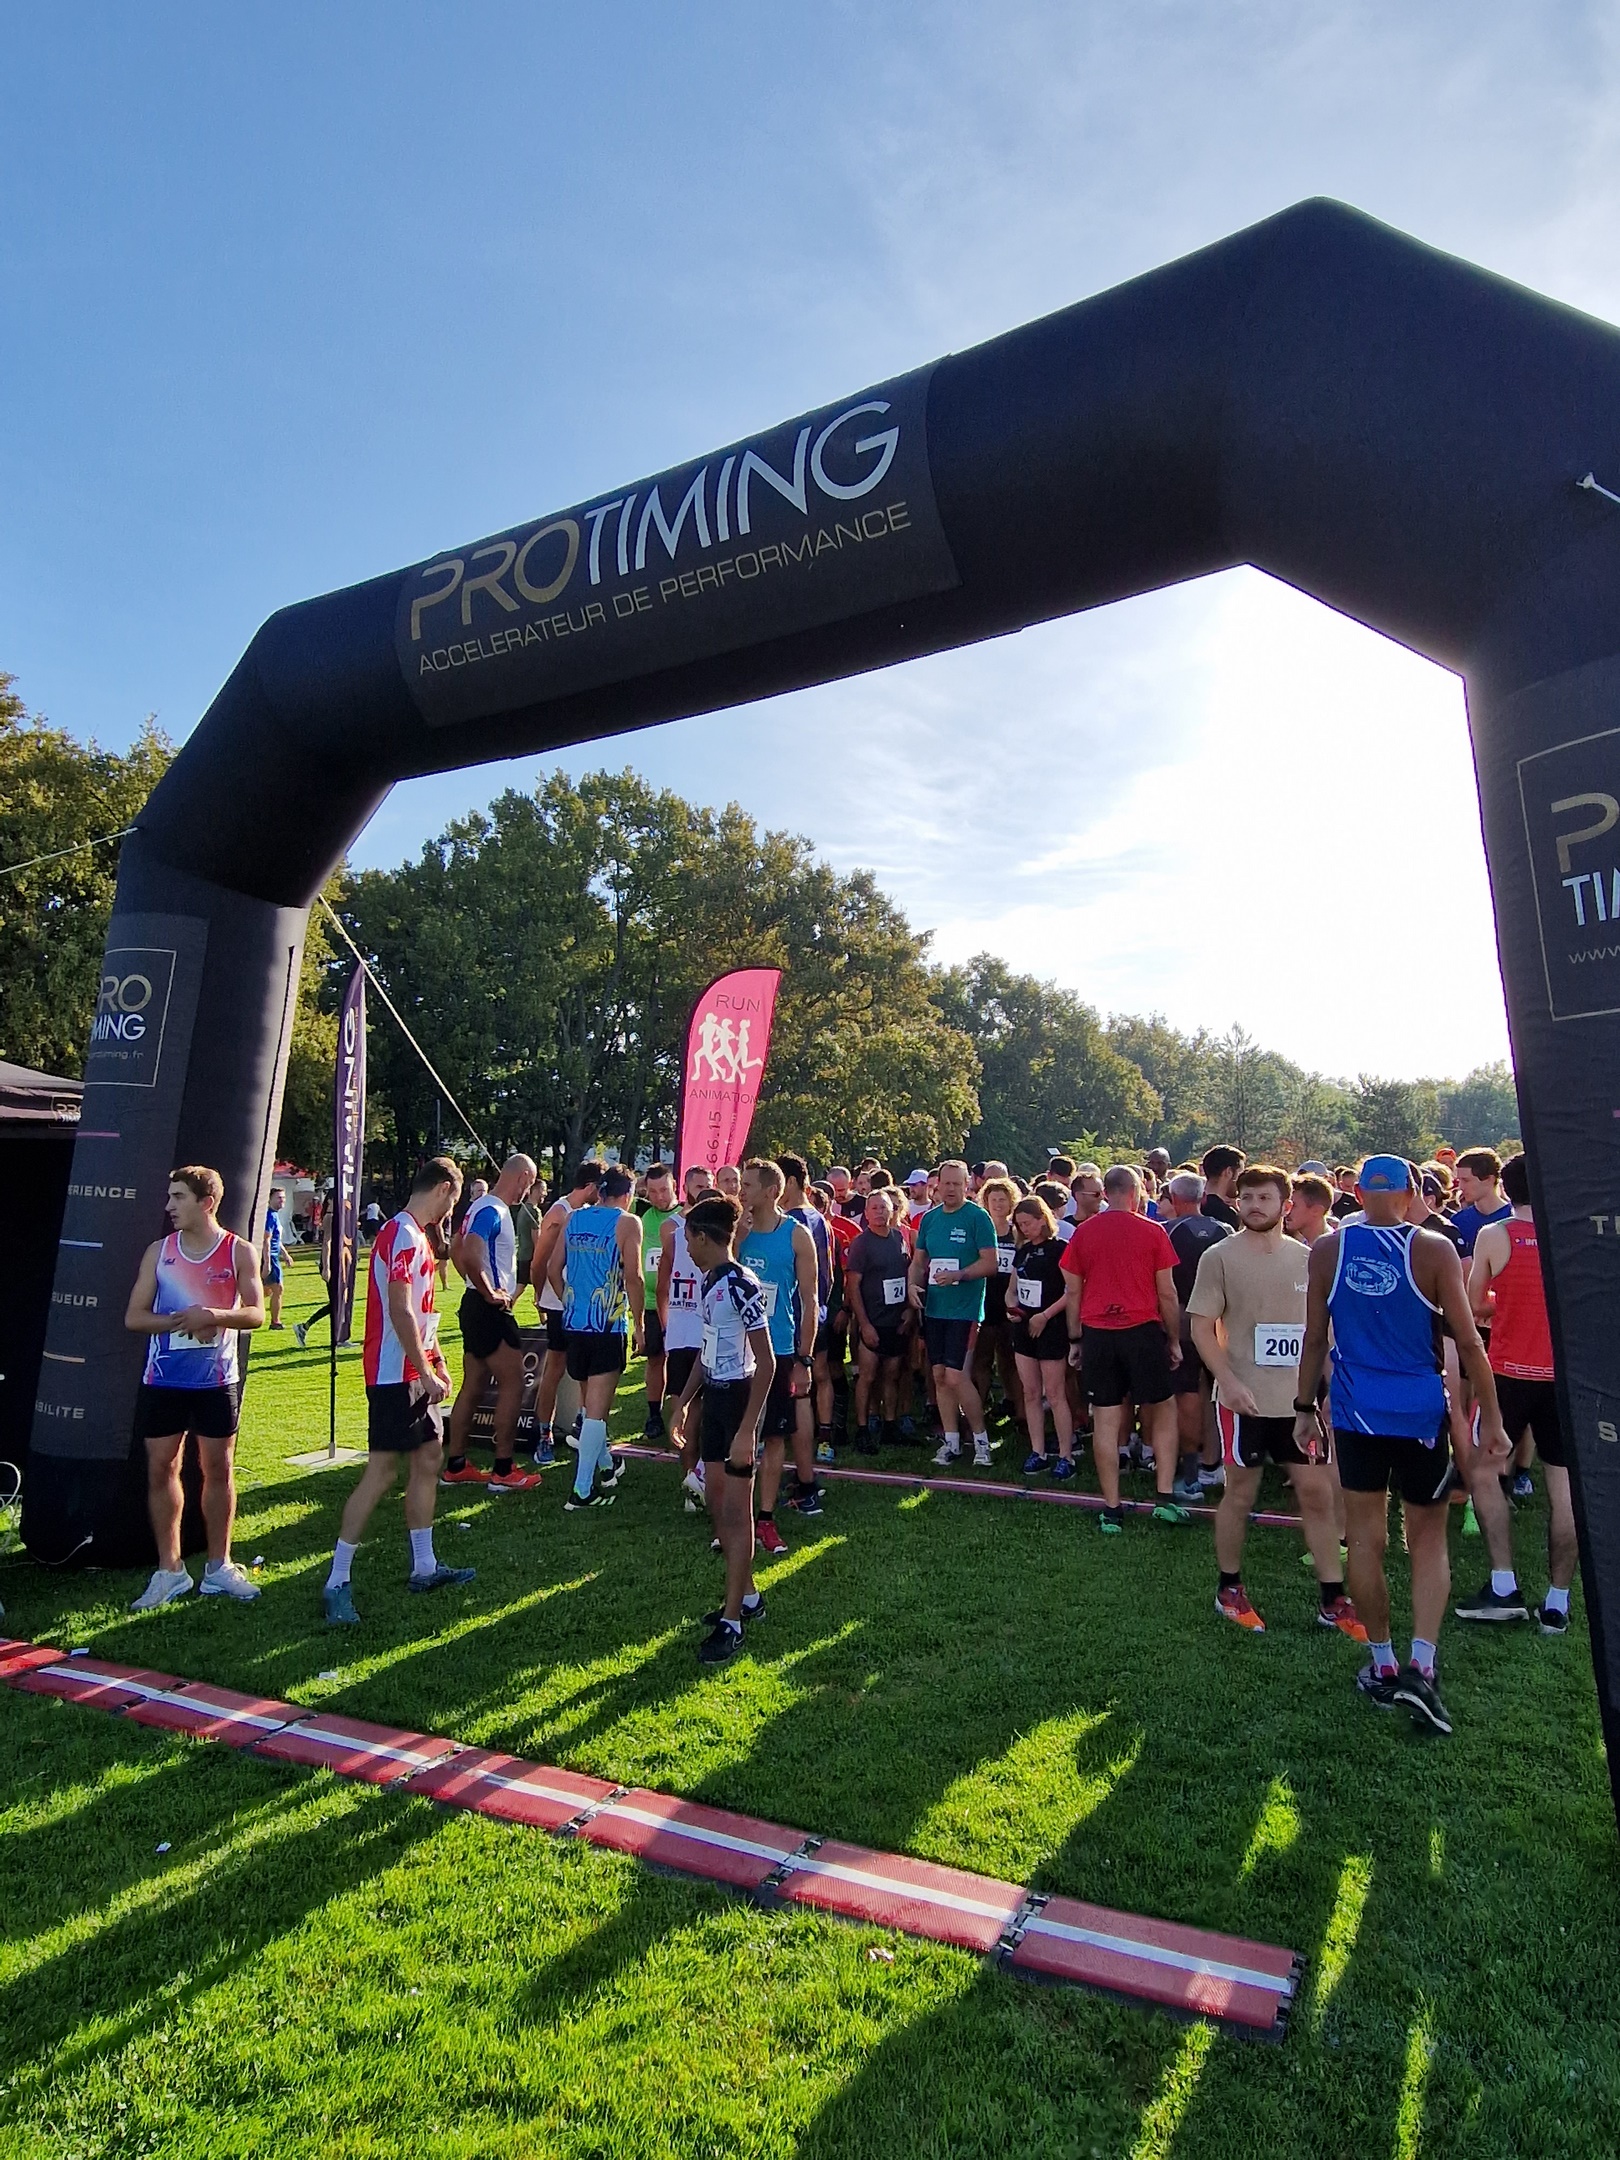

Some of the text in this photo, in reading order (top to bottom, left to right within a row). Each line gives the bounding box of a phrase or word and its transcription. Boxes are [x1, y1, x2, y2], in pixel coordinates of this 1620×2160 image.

[410, 400, 899, 641] PROTIMING
[417, 501, 912, 676] ACCELERATEUR DE PERFORMANCE
[97, 973, 152, 1012] RO
[715, 994, 761, 1013] RUN
[1265, 1338, 1300, 1357] 200
